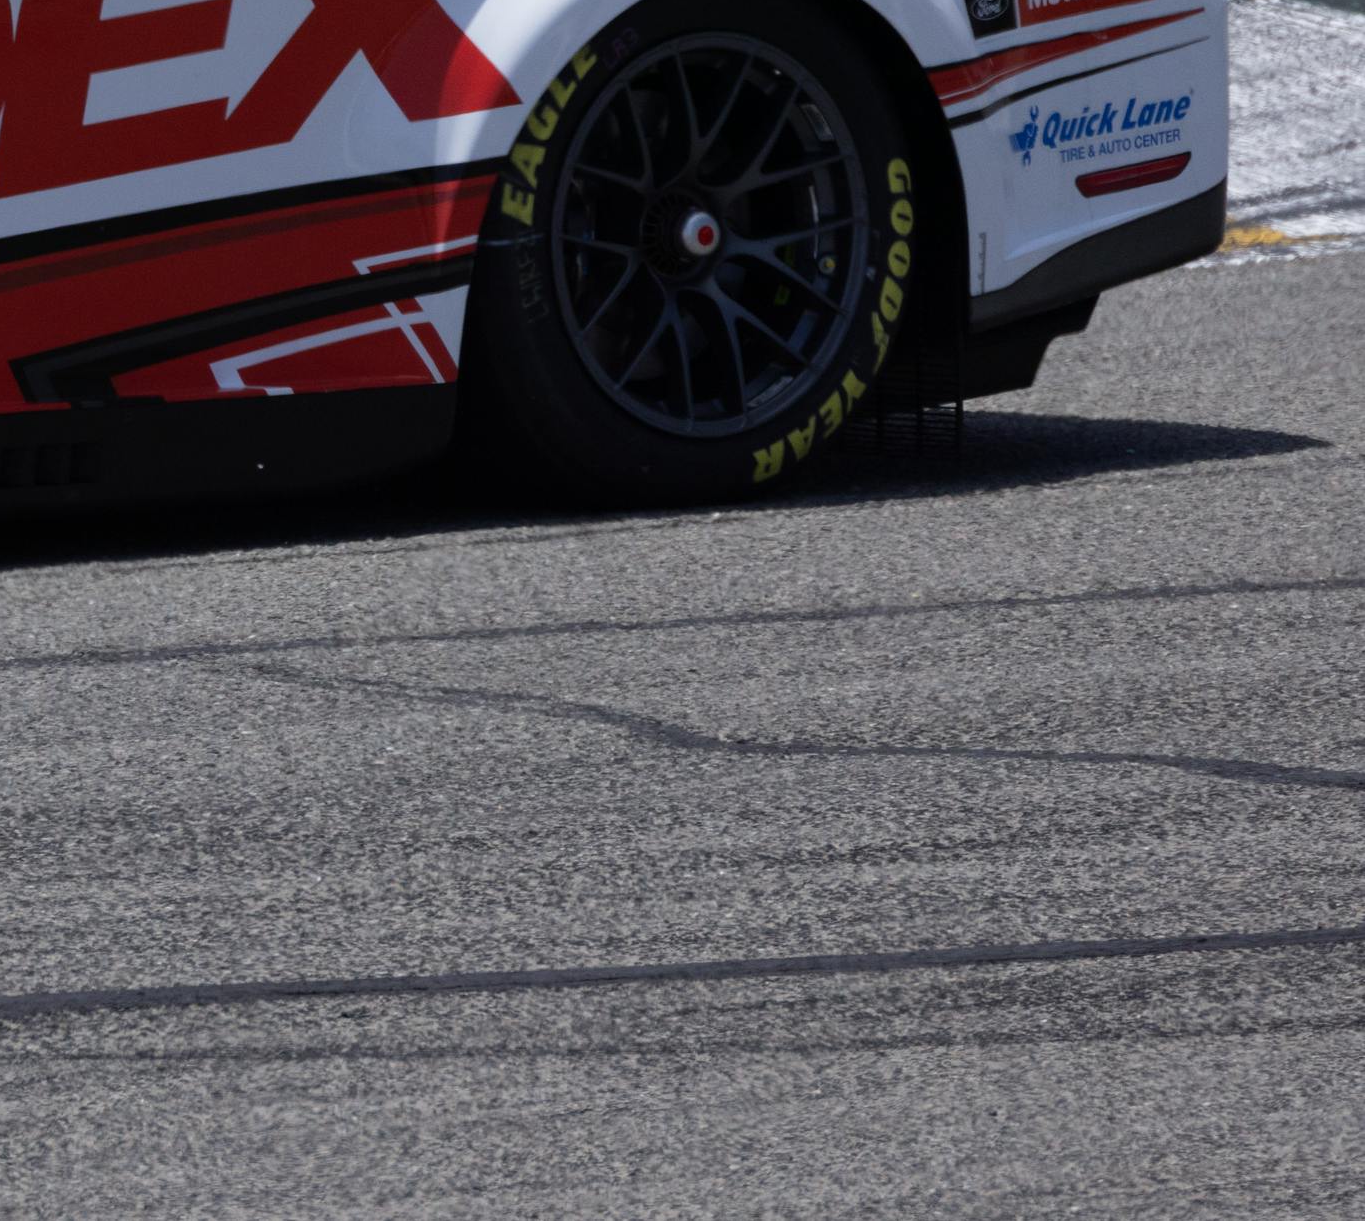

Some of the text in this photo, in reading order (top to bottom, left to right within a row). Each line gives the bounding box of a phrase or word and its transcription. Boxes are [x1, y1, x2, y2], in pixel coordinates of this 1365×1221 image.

[501, 43, 598, 226] EAGLE
[1042, 95, 1191, 149] Quick Lane
[1059, 128, 1181, 164] TIRE & AUTO CENTER
